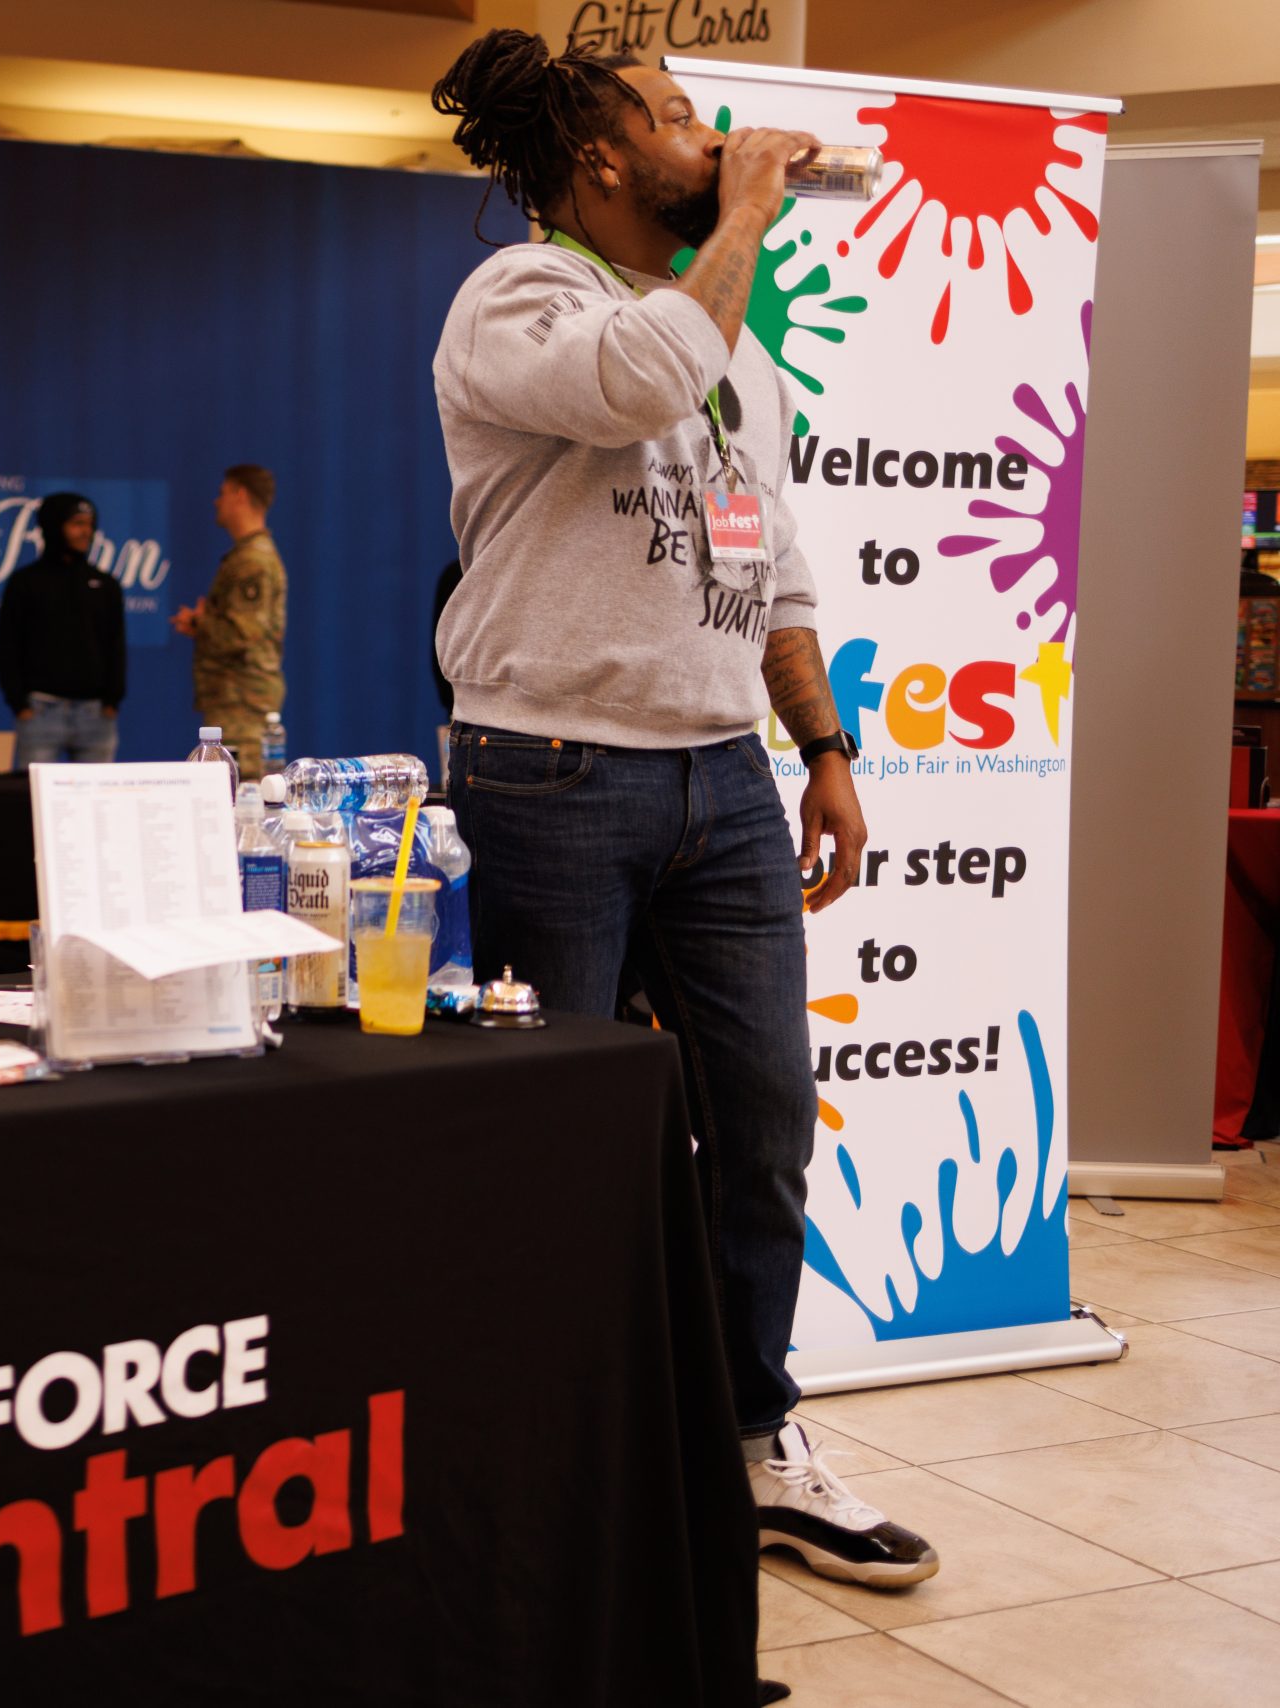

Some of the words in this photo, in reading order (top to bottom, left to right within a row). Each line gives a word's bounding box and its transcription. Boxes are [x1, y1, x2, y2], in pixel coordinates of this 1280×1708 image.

[571, 0, 663, 53] Gift
[665, 0, 770, 48] Cards
[788, 434, 1029, 491] Welcome
[612, 486, 699, 521] WANNA
[647, 518, 689, 565] BE
[858, 539, 921, 586] to
[851, 755, 875, 775] ult
[879, 754, 910, 781] Job
[916, 754, 949, 775] Fair
[956, 754, 971, 774] in
[975, 753, 1066, 778] Washington
[287, 866, 330, 893] Liquid
[904, 841, 1027, 898] step
[288, 888, 330, 910] Death
[857, 938, 918, 984] to
[809, 1025, 1001, 1083] uccess!
